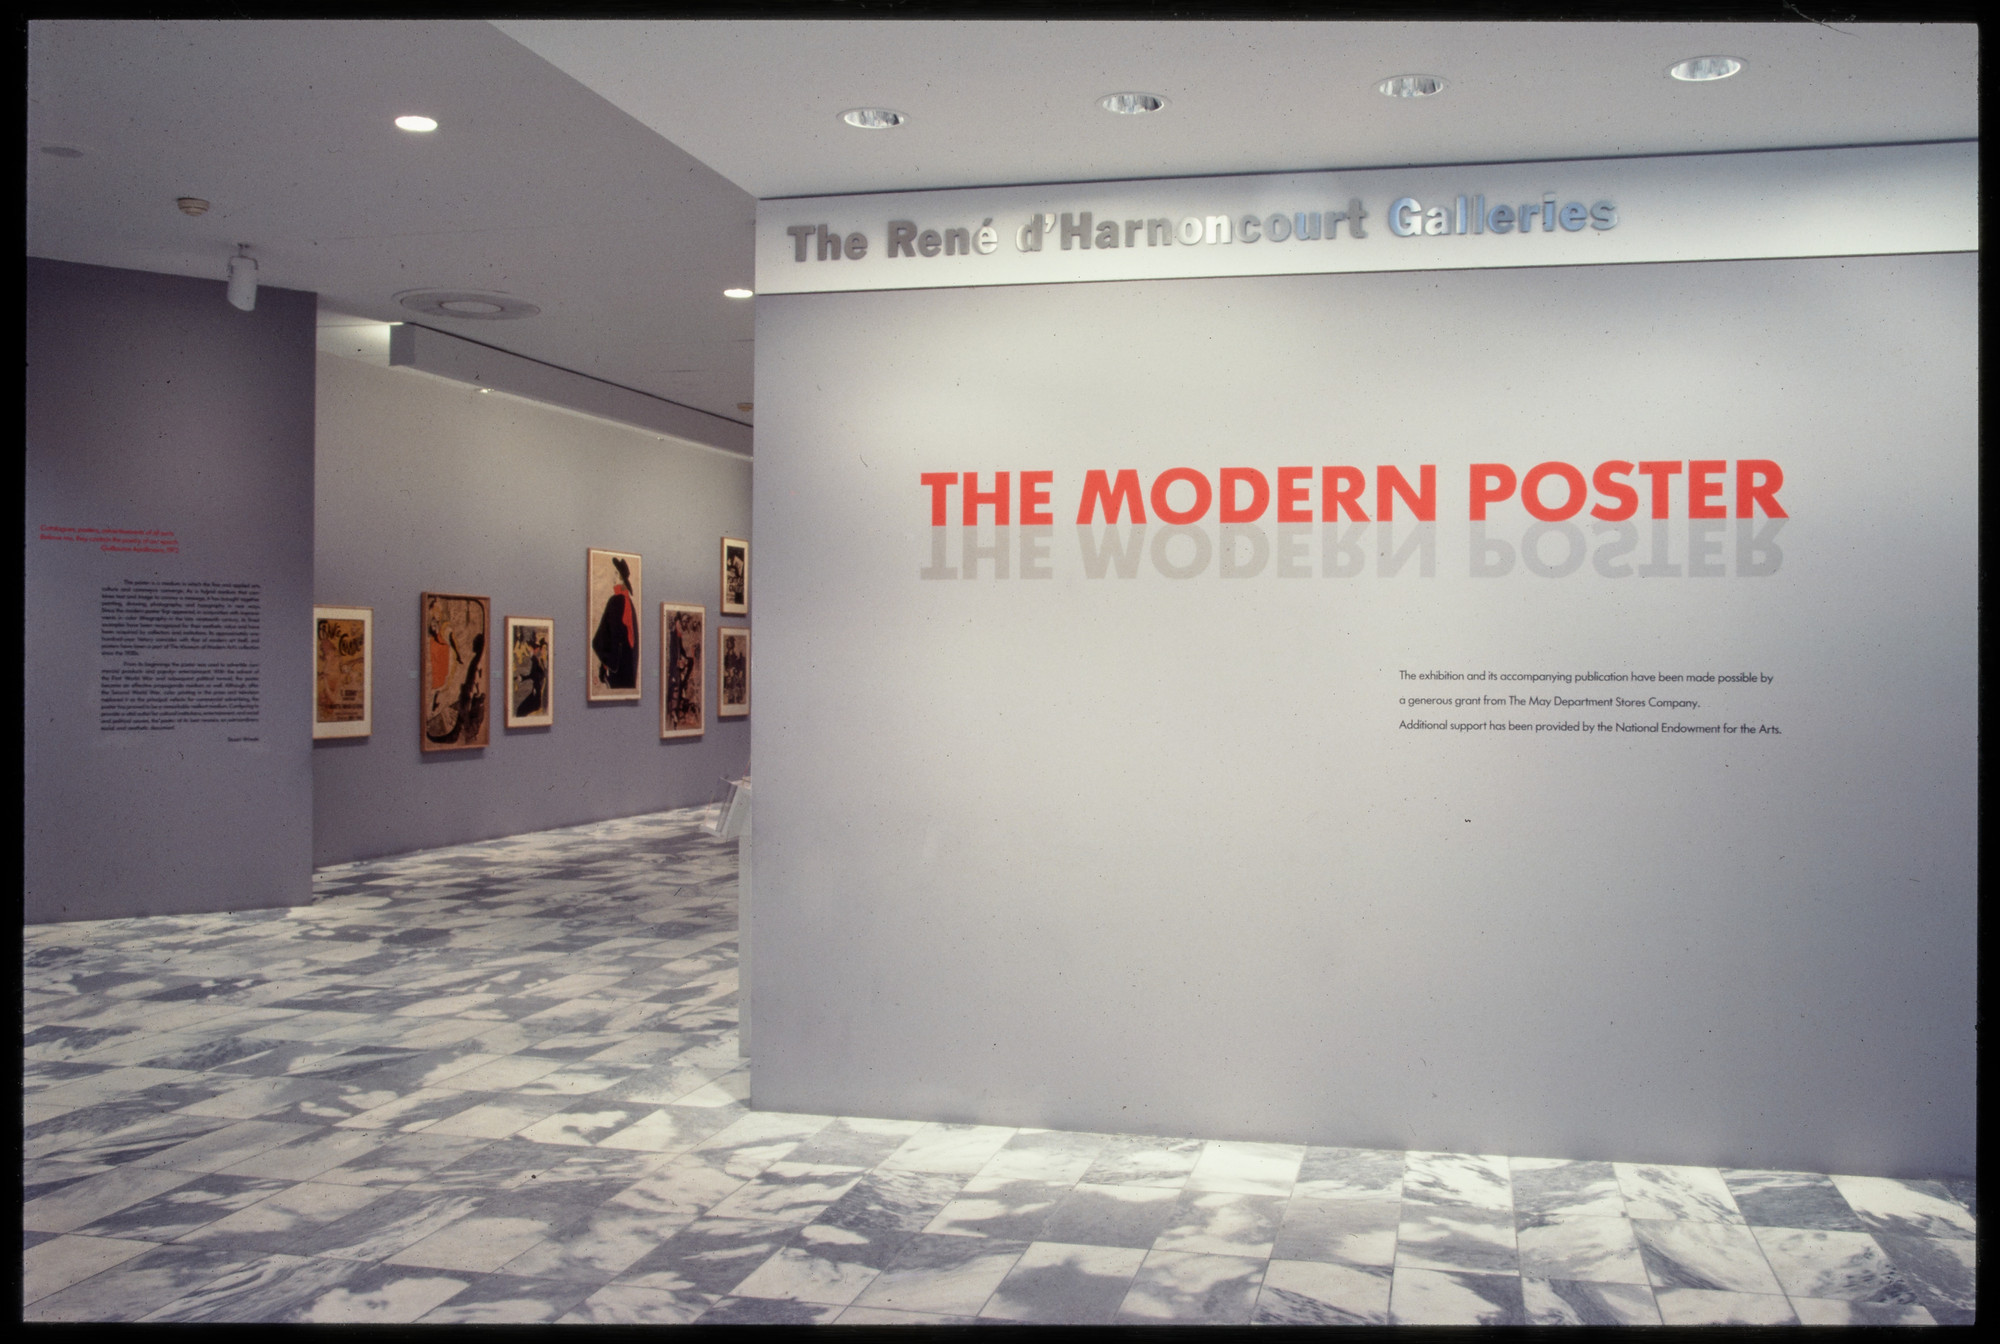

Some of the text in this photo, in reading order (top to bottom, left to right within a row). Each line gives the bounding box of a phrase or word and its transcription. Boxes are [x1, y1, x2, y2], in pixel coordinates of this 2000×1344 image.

[785, 194, 1618, 264] The René d'Harnoncourt Galleries
[920, 459, 1788, 526] THE MODERN POSTER
[1399, 670, 1774, 685] The exhibition and its accompanying publication have been made possible by
[1408, 698, 1452, 707] generous
[1455, 697, 1481, 707] grant
[1483, 695, 1506, 705] from
[1509, 695, 1526, 706] The
[1529, 696, 1552, 708] May
[1554, 696, 1613, 708] Department
[1616, 697, 1646, 707] Stores
[1648, 697, 1700, 710] Company.
[1399, 719, 1782, 734] Additional support has been provided by the National Endowment for the Arts.
